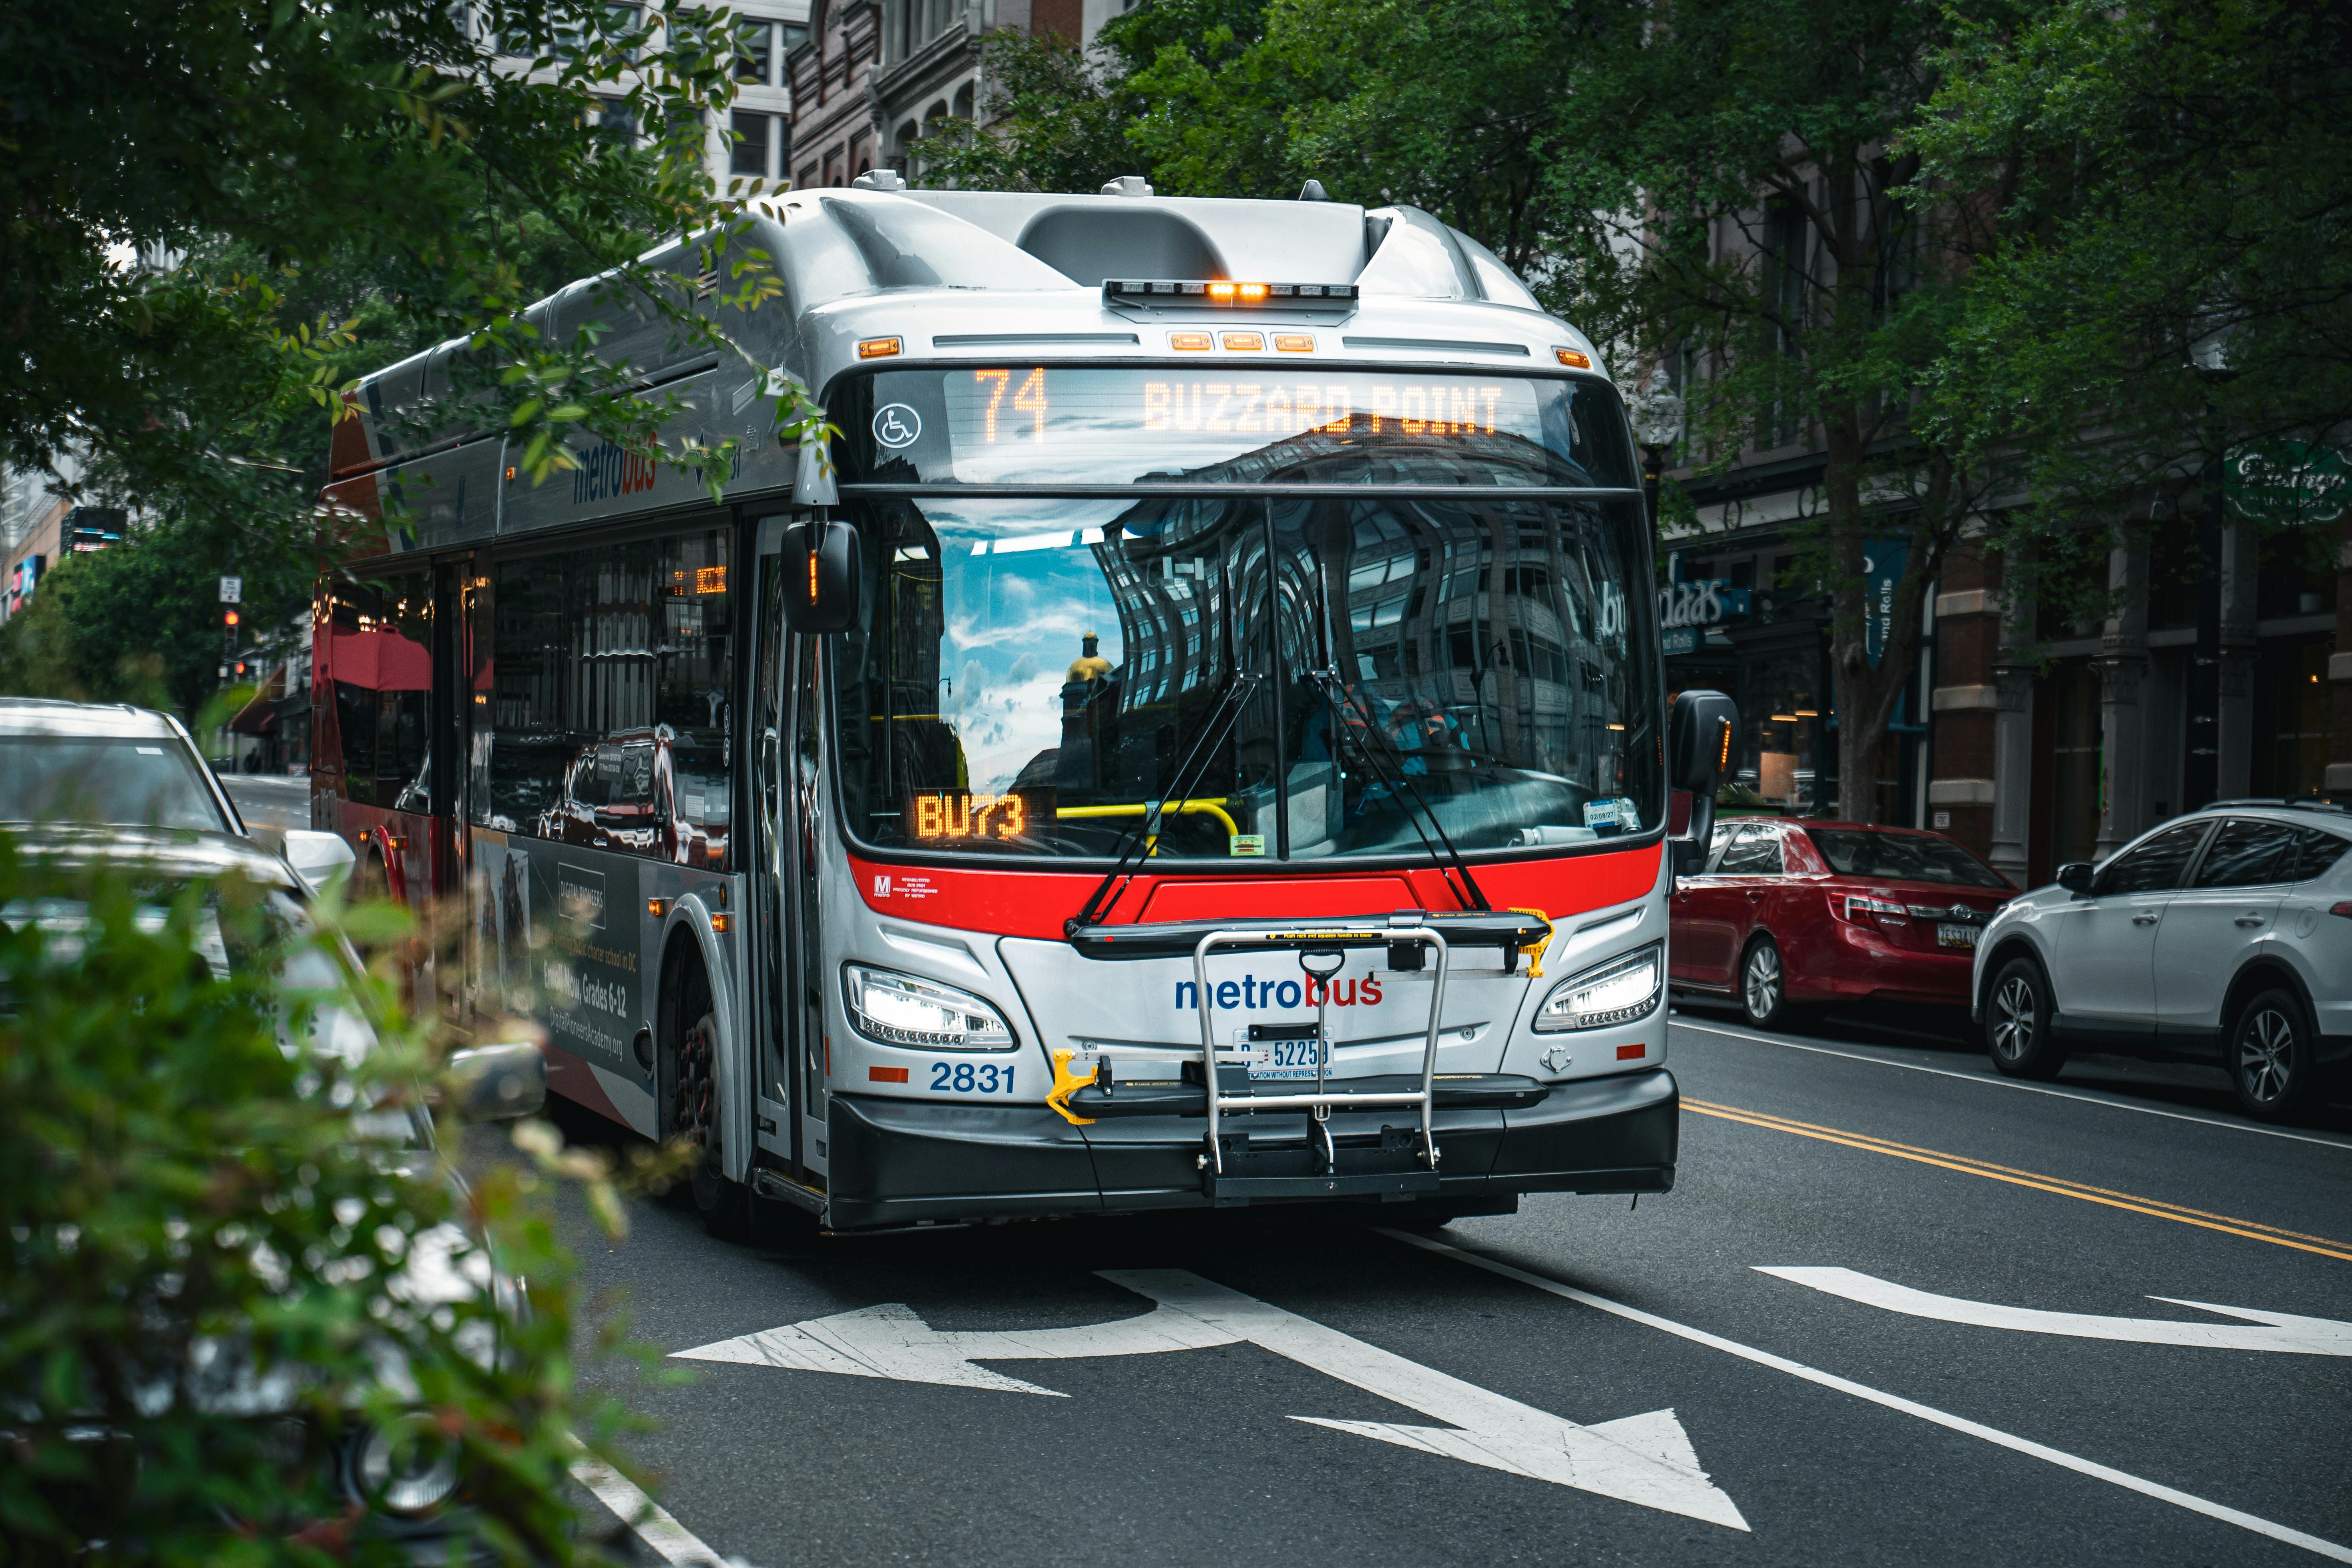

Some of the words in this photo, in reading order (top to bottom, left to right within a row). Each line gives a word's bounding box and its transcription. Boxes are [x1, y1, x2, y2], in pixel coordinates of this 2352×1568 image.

[976, 367, 1047, 442] 74
[1145, 383, 1351, 433] BUZZARD
[1372, 386, 1501, 434] POINT
[574, 424, 657, 505] metrobus
[918, 794, 1024, 837] BU73
[1590, 811, 1614, 820] 02/08/27
[560, 881, 577, 900] DIGITAL
[580, 885, 603, 909] PIONEERS
[876, 877, 890, 892] M
[588, 941, 604, 962] charter
[605, 946, 621, 968] school
[622, 950, 627, 970] in
[629, 952, 637, 974] DC
[583, 973, 608, 1012] Grades
[609, 982, 626, 1018] 6-12
[1175, 974, 1383, 1010] metrobus
[550, 1006, 623, 1062] DigitalPioneersAcademy.org
[930, 1062, 1014, 1094] 2831
[1271, 1070, 1291, 1079] WITHOUT
[1293, 1069, 1332, 1078] REPRESETION
